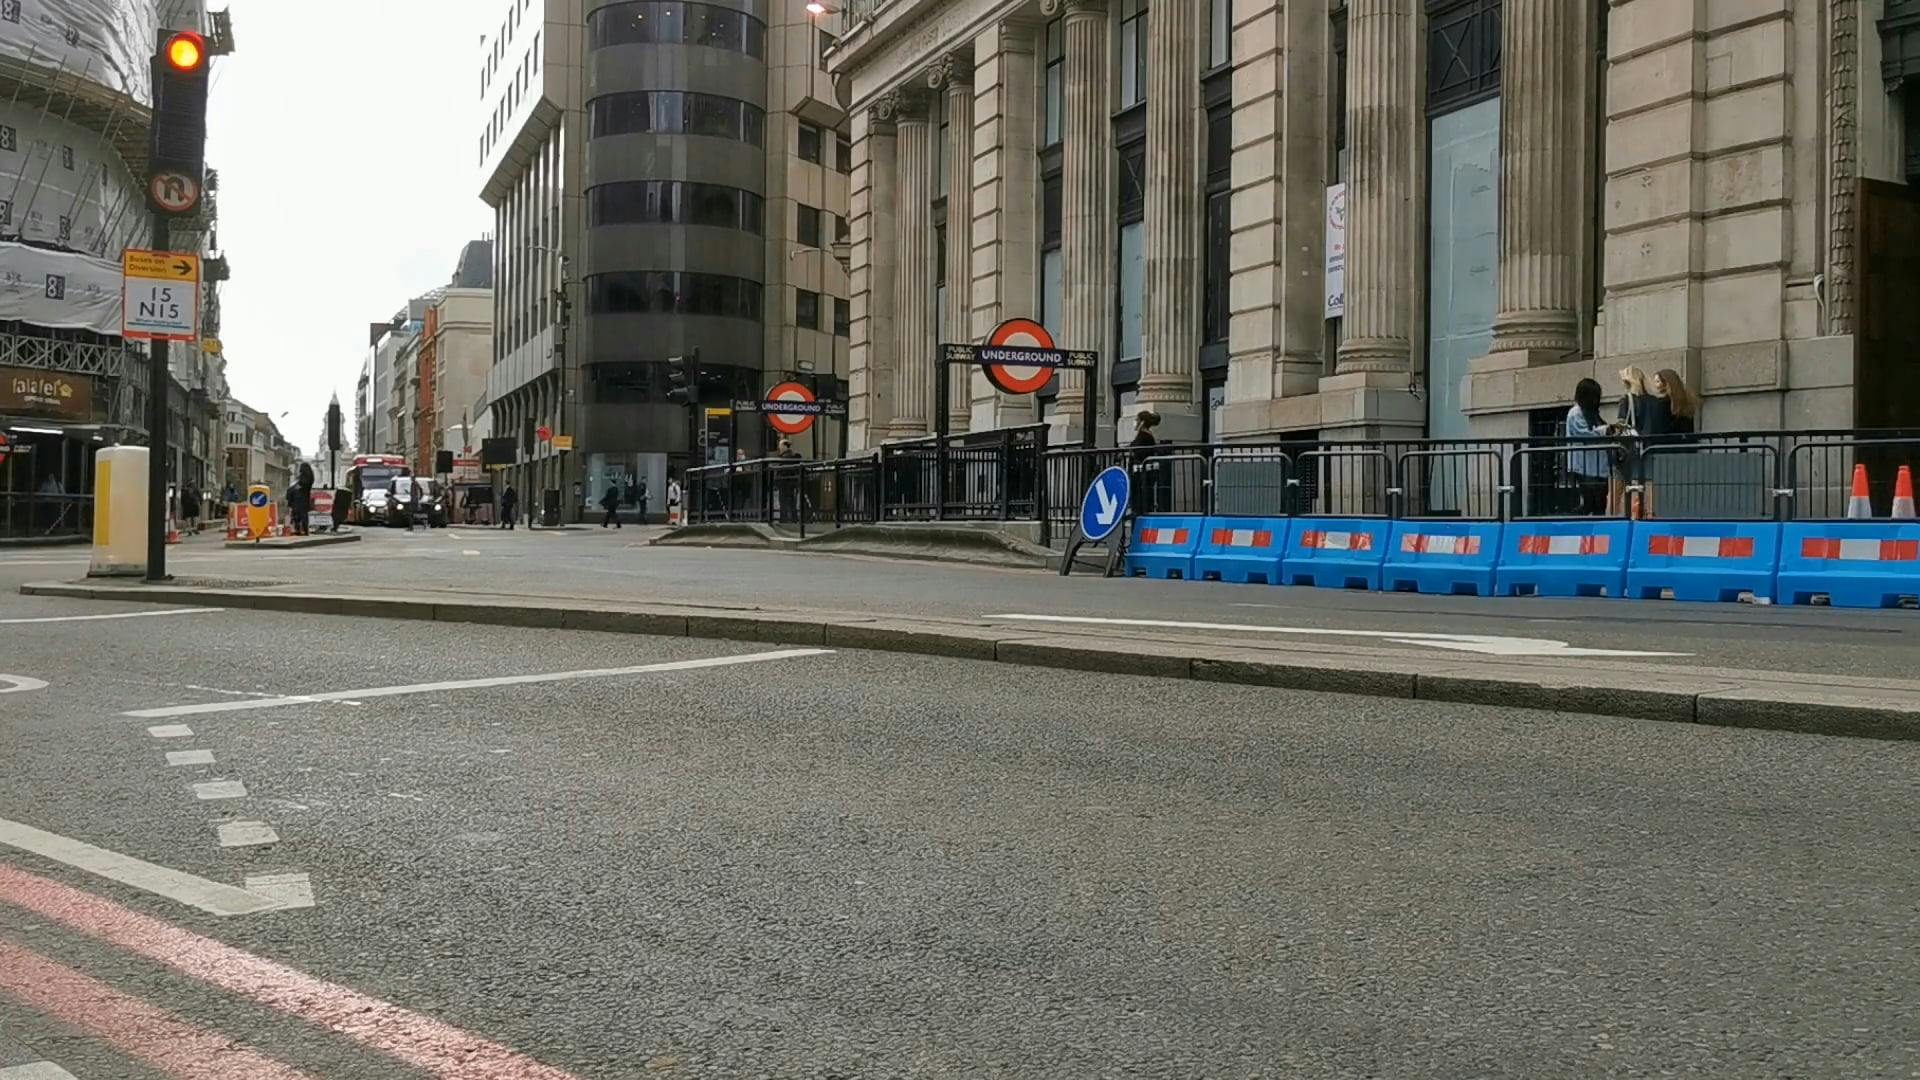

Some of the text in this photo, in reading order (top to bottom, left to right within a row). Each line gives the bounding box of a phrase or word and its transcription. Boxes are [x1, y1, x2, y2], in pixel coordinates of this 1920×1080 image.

[129, 255, 152, 263] Buses
[128, 263, 168, 273] Diversion
[151, 287, 172, 302] 15
[139, 301, 179, 319] N15
[945, 353, 976, 361] SUBWAY
[981, 350, 1062, 362] UNDERGROUND
[1067, 359, 1095, 367] SUBWAY
[761, 403, 821, 412] UNDERGROUND
